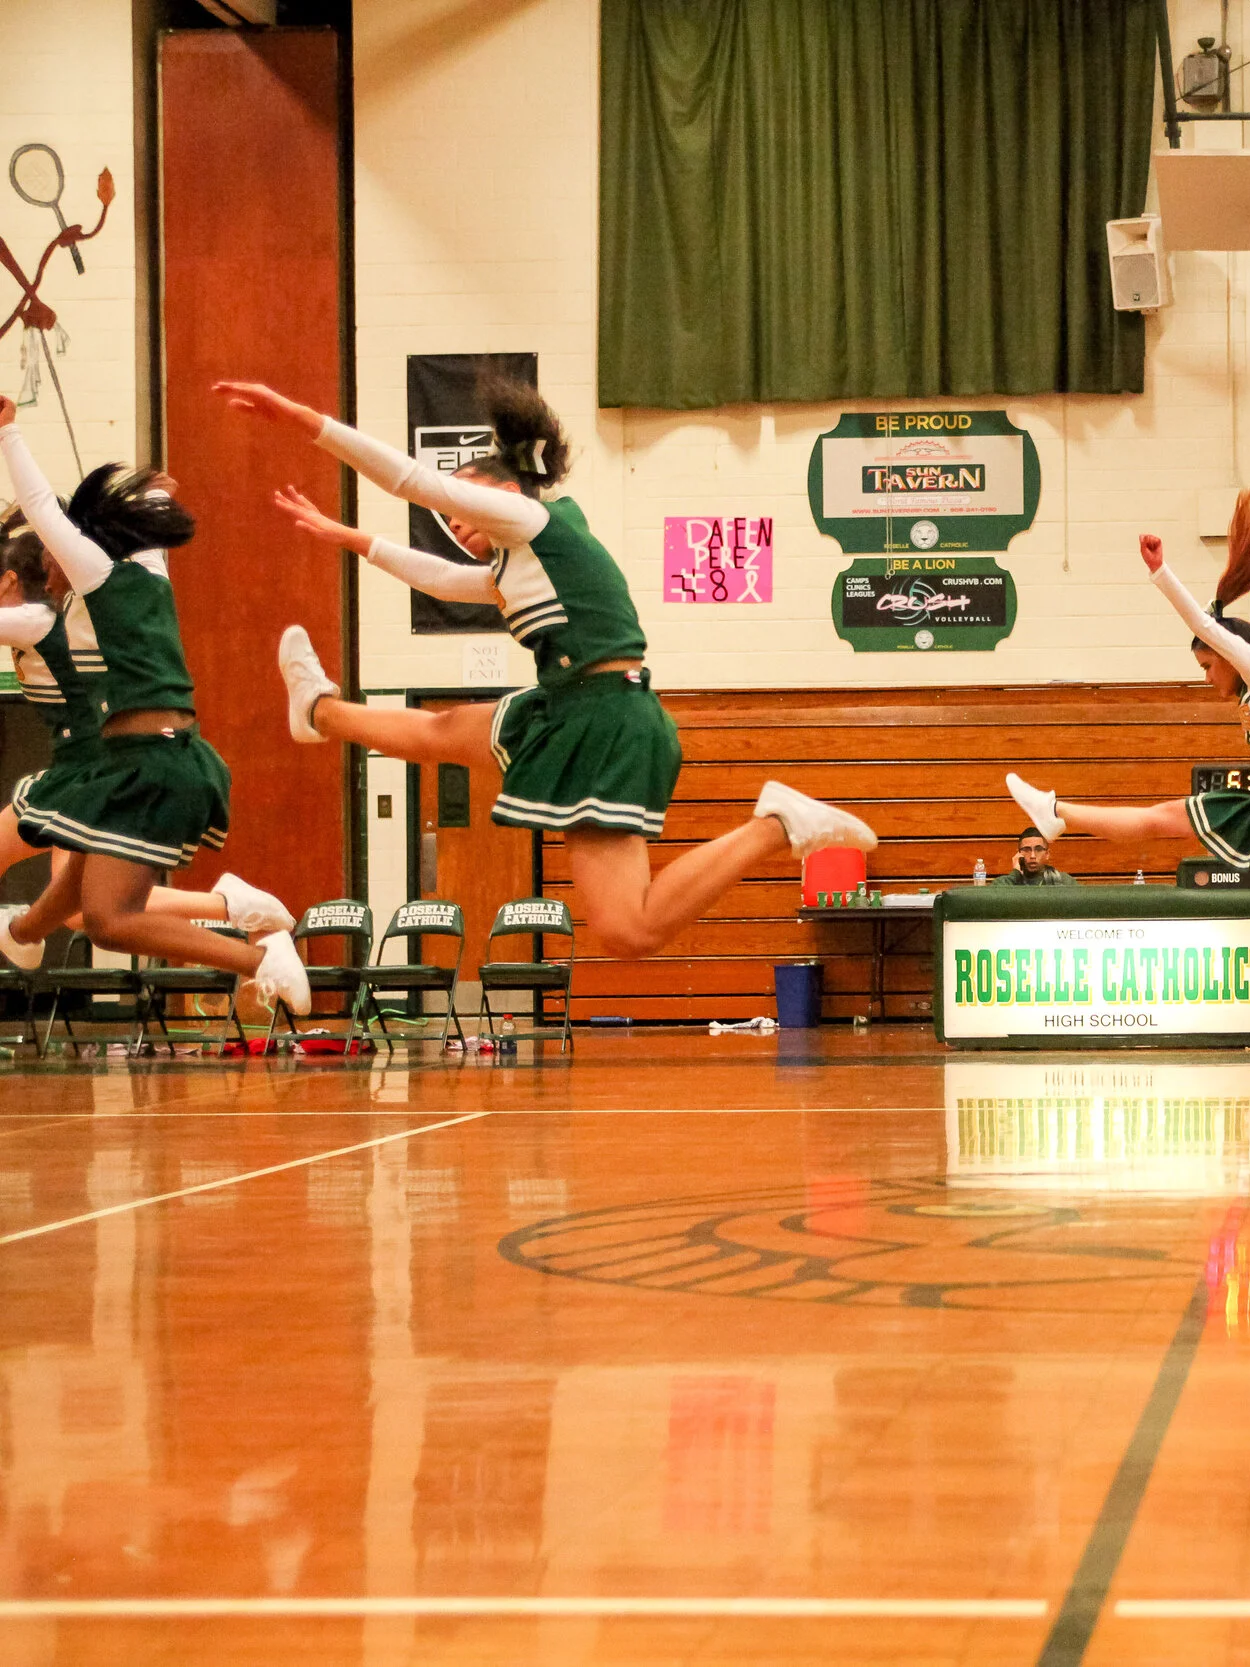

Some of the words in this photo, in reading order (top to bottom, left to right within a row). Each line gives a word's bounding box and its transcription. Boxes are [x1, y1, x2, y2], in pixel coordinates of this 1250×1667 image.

[875, 415, 900, 431] BE
[905, 414, 972, 430] PROUD
[905, 466, 942, 478] SUN
[867, 467, 981, 491] TAVERN
[694, 545, 762, 570] PEREZ
[893, 560, 909, 570] BE
[912, 560, 922, 570] A
[925, 559, 956, 570] LION
[876, 593, 971, 611] CRUSH
[1211, 873, 1241, 884] BONUS
[309, 905, 366, 917] ROSELLE
[399, 904, 456, 917] ROSELLE
[504, 903, 564, 915] ROSELLE
[307, 916, 364, 929] CATHOLIC
[397, 915, 453, 928] CATHOLIC
[503, 914, 563, 926] CATHOLIC
[1056, 928, 1124, 940] WELCOME
[1128, 928, 1145, 939] TO
[955, 948, 1092, 1005] ROSELLE
[1044, 1014, 1084, 1028] HIGH
[1089, 1013, 1159, 1028] SCHOOL
